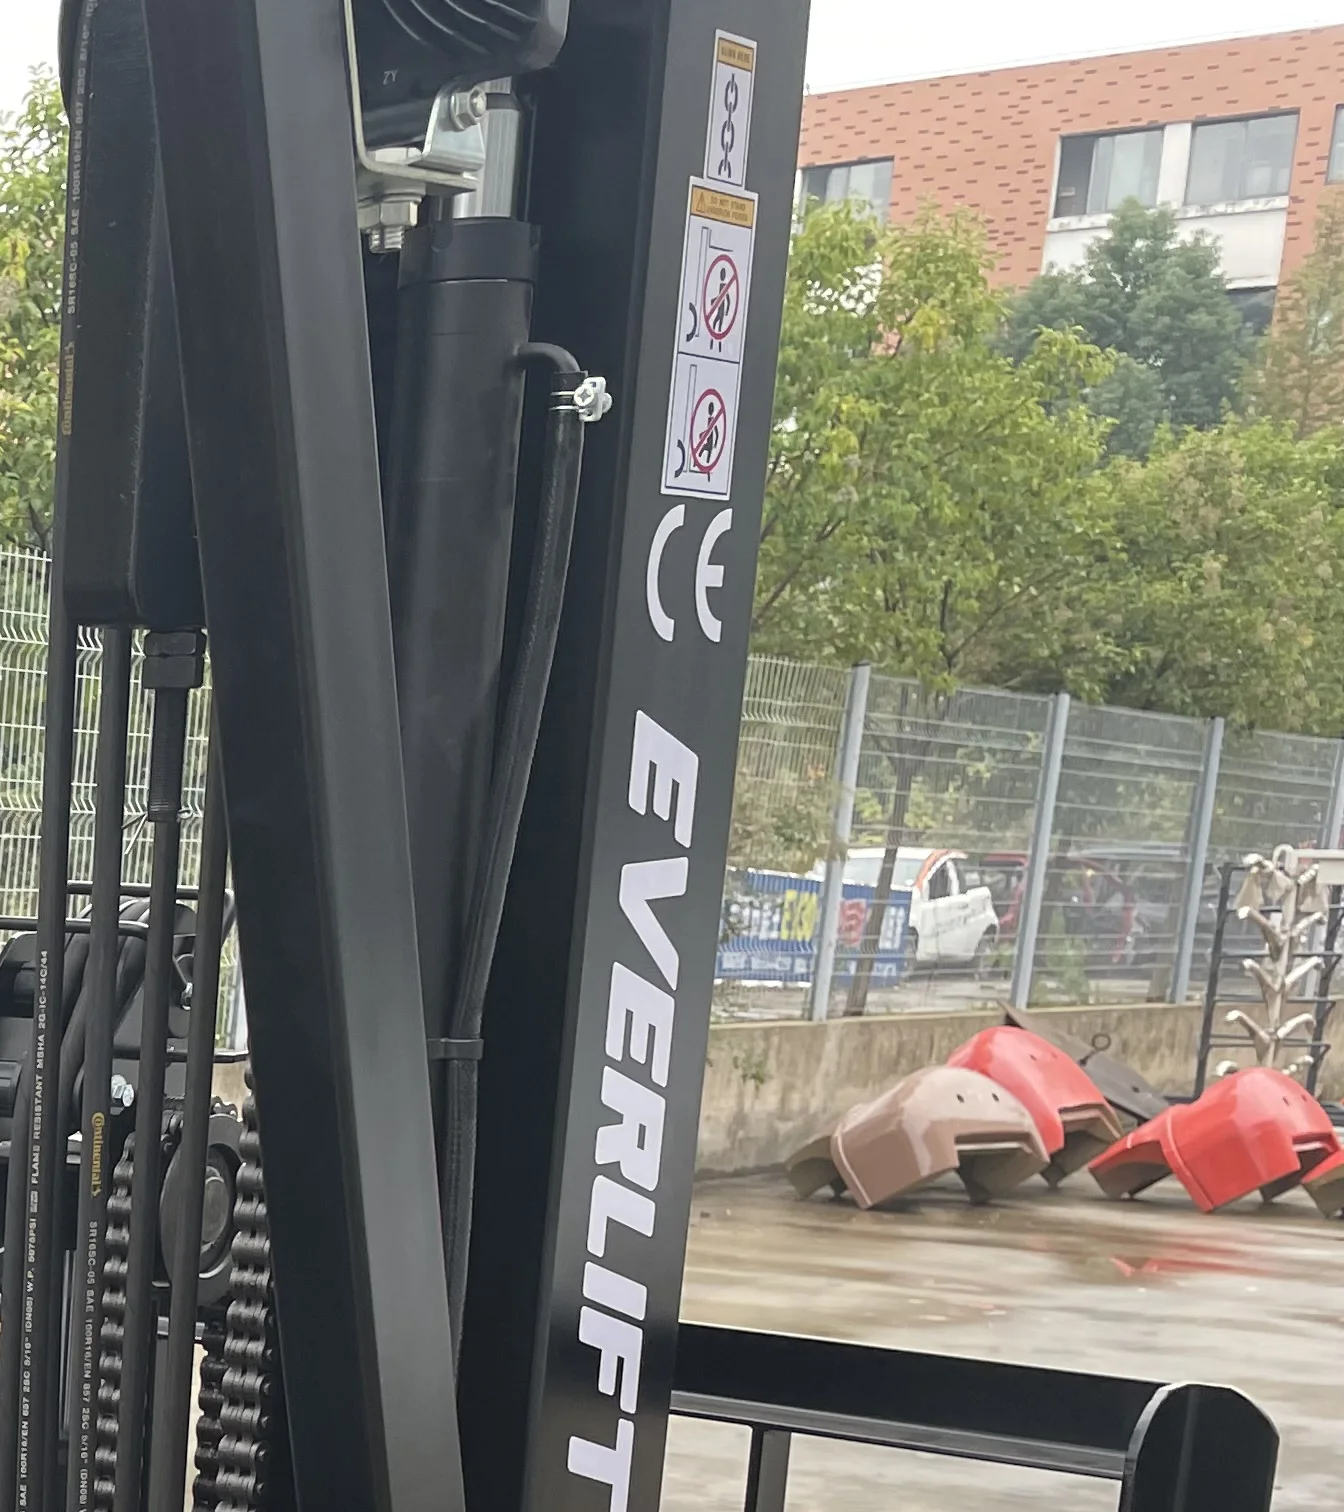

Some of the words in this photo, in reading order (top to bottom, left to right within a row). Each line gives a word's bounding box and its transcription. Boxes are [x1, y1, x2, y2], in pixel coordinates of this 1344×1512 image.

[646, 503, 736, 645] CE
[35, 1034, 46, 1069] MSHA
[33, 1074, 43, 1139] RESISTANT
[30, 1145, 41, 1185] FLAME
[91, 1112, 105, 1186] Continental
[85, 1289, 95, 1313] SAE
[18, 1484, 27, 1507] SAE
